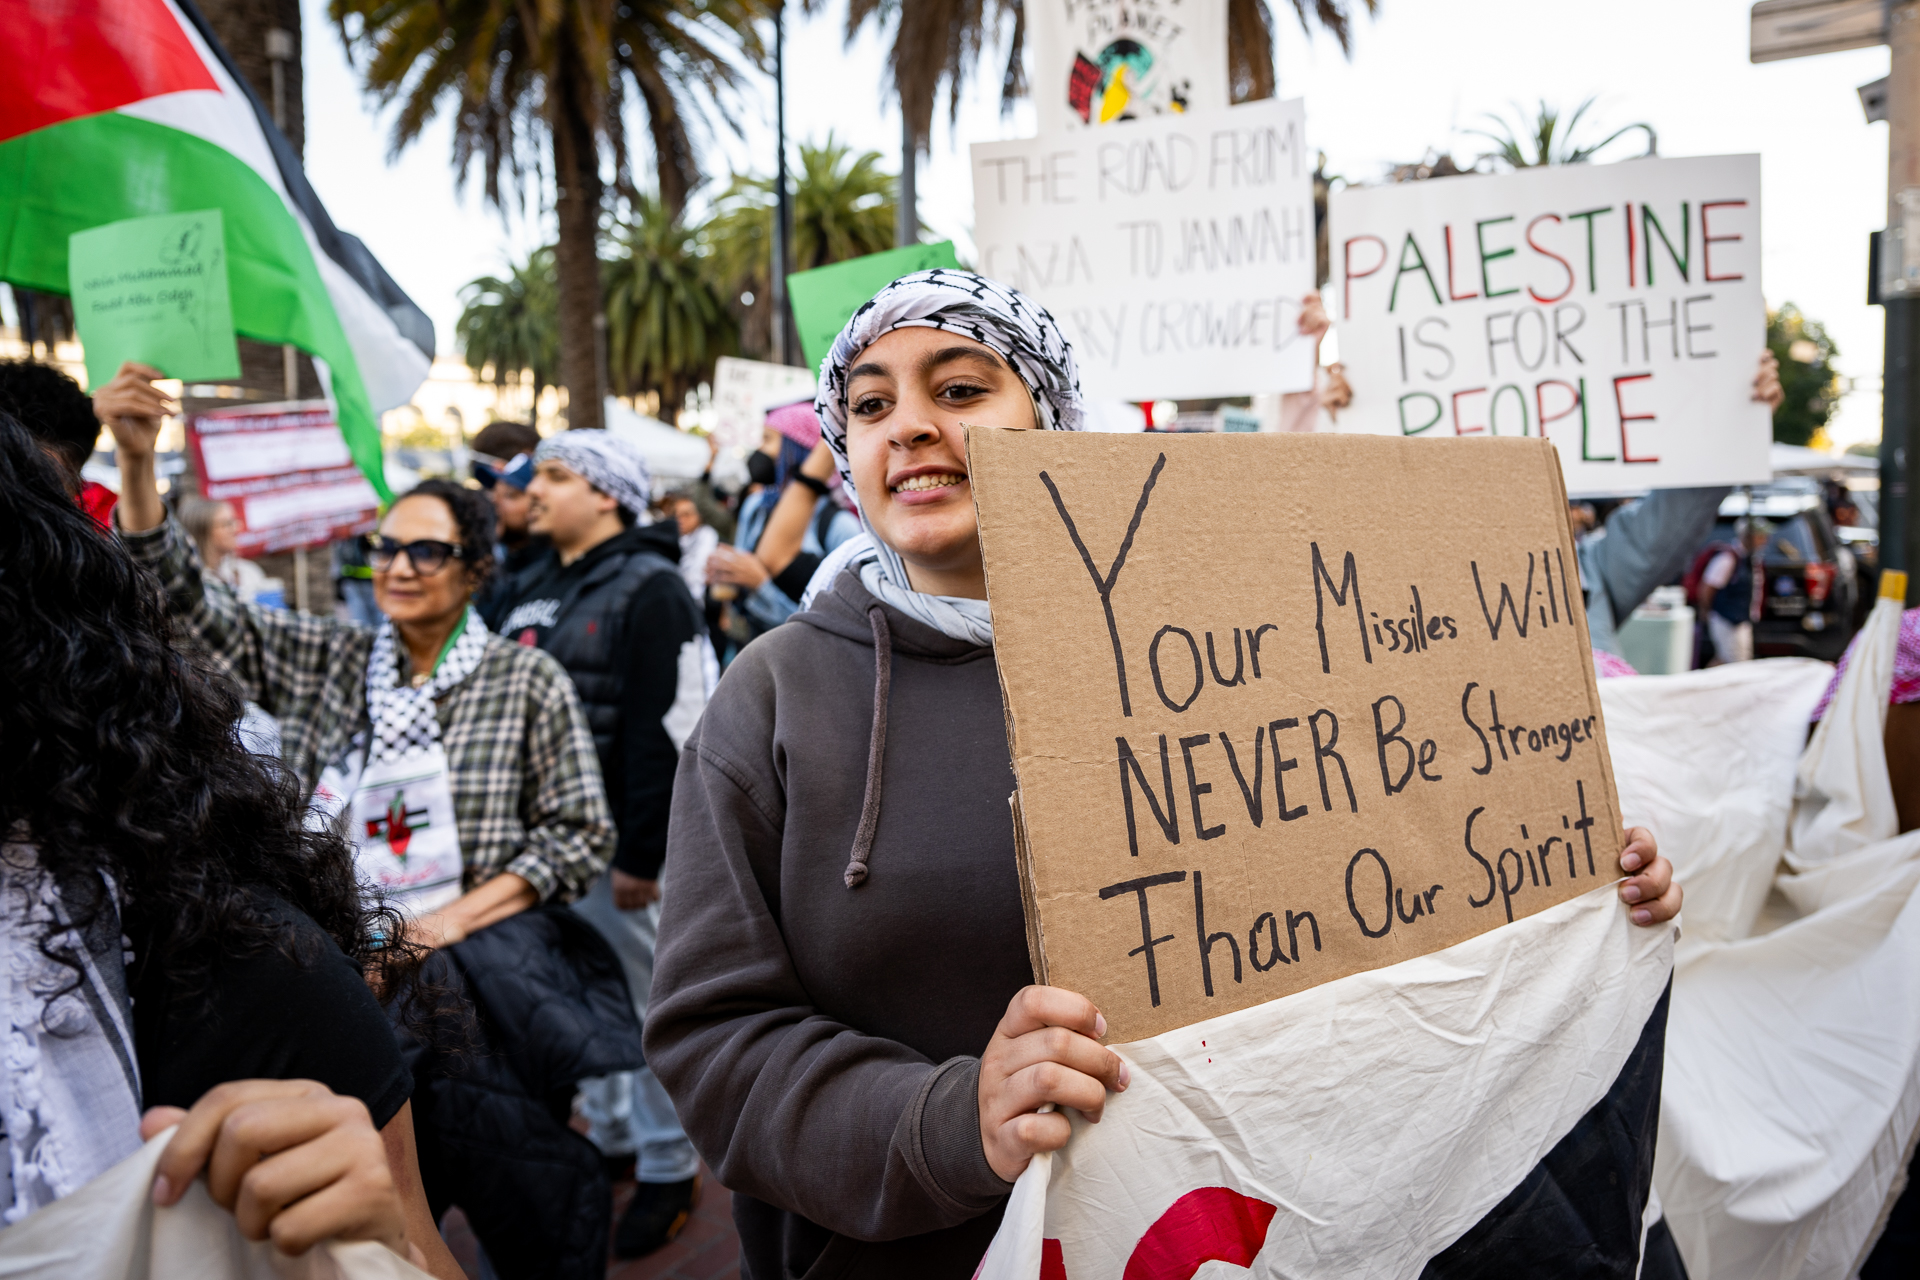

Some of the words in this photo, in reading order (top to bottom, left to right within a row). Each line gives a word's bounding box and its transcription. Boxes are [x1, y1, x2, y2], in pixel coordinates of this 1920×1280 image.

[980, 150, 1078, 205] THE
[1097, 132, 1199, 199] ROAD
[1208, 120, 1301, 190] FROM
[1116, 219, 1164, 278] TO
[1174, 205, 1306, 274] JANNAH
[1343, 199, 1748, 321] PALESTINE
[1139, 296, 1303, 356] CROWDED
[1398, 315, 1455, 382] IS
[1485, 302, 1587, 377] FOR
[1607, 294, 1718, 364] THE
[1398, 373, 1660, 463] PEOPLE
[1040, 452, 1278, 717] Your
[1310, 541, 1458, 674] Missiles
[1471, 547, 1574, 641] Will
[1115, 708, 1358, 857] NEVER
[1371, 695, 1443, 796] Be
[1461, 682, 1598, 776] Stronger
[1099, 870, 1322, 1008] Than
[1345, 848, 1444, 938] Our
[1464, 780, 1597, 924] Spirit
